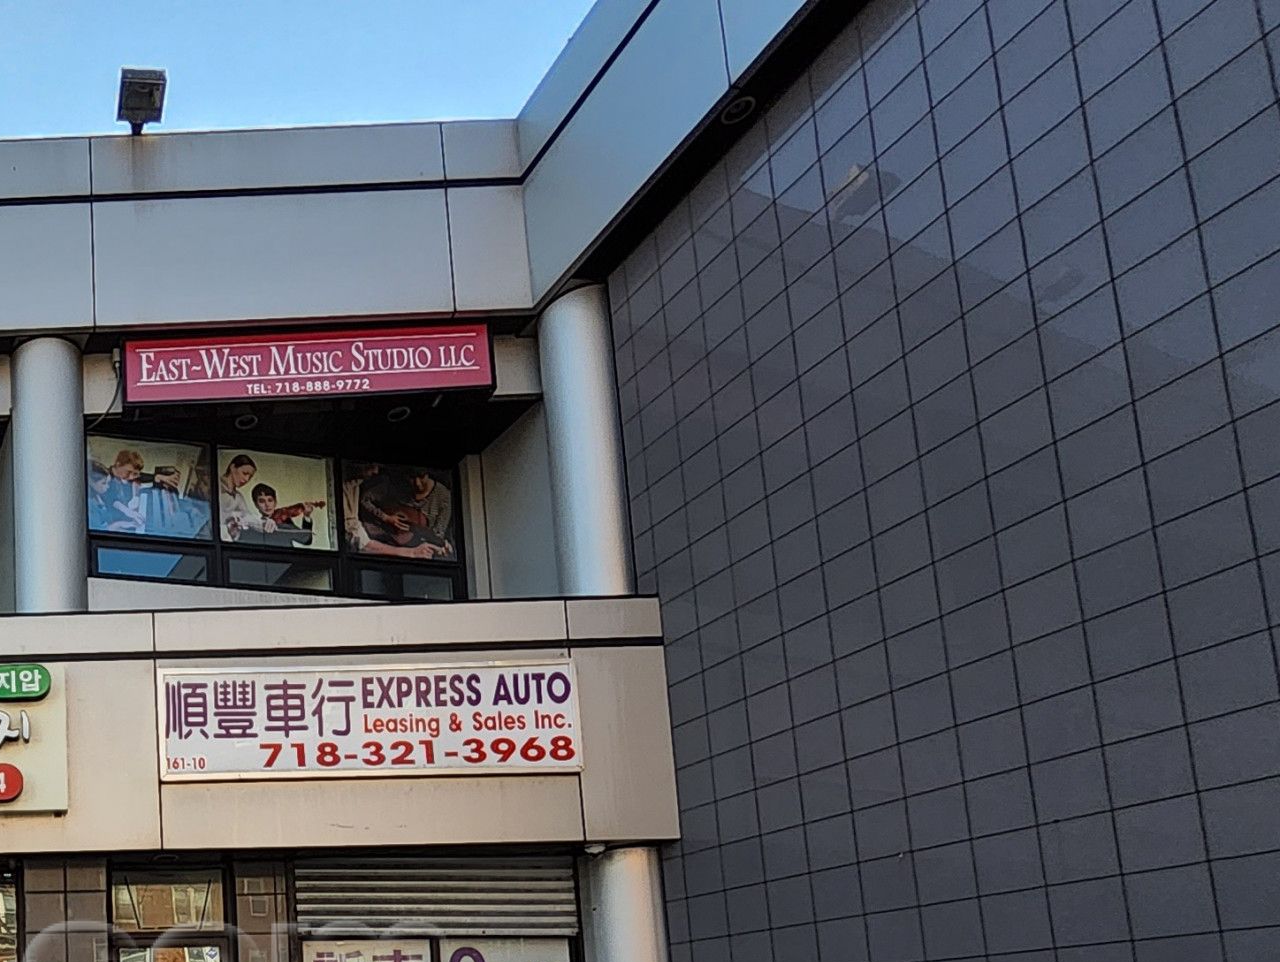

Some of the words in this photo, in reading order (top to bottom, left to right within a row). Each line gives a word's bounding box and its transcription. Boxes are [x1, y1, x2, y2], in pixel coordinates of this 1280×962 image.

[269, 345, 343, 376] MUSIC
[351, 341, 432, 372] STUDIO
[440, 344, 476, 367] LLC
[247, 383, 271, 395] TEL:
[275, 379, 370, 393] 718-888-9772
[361, 672, 482, 709] EXPRESS
[492, 671, 572, 706] AUTO
[165, 677, 357, 740] 順豐車行
[363, 713, 440, 738] Leasing
[449, 712, 463, 732] &
[472, 709, 526, 731] Sales
[534, 708, 573, 730] Inc.
[166, 756, 207, 771] 161-10
[258, 735, 576, 769] 718-321-3968
